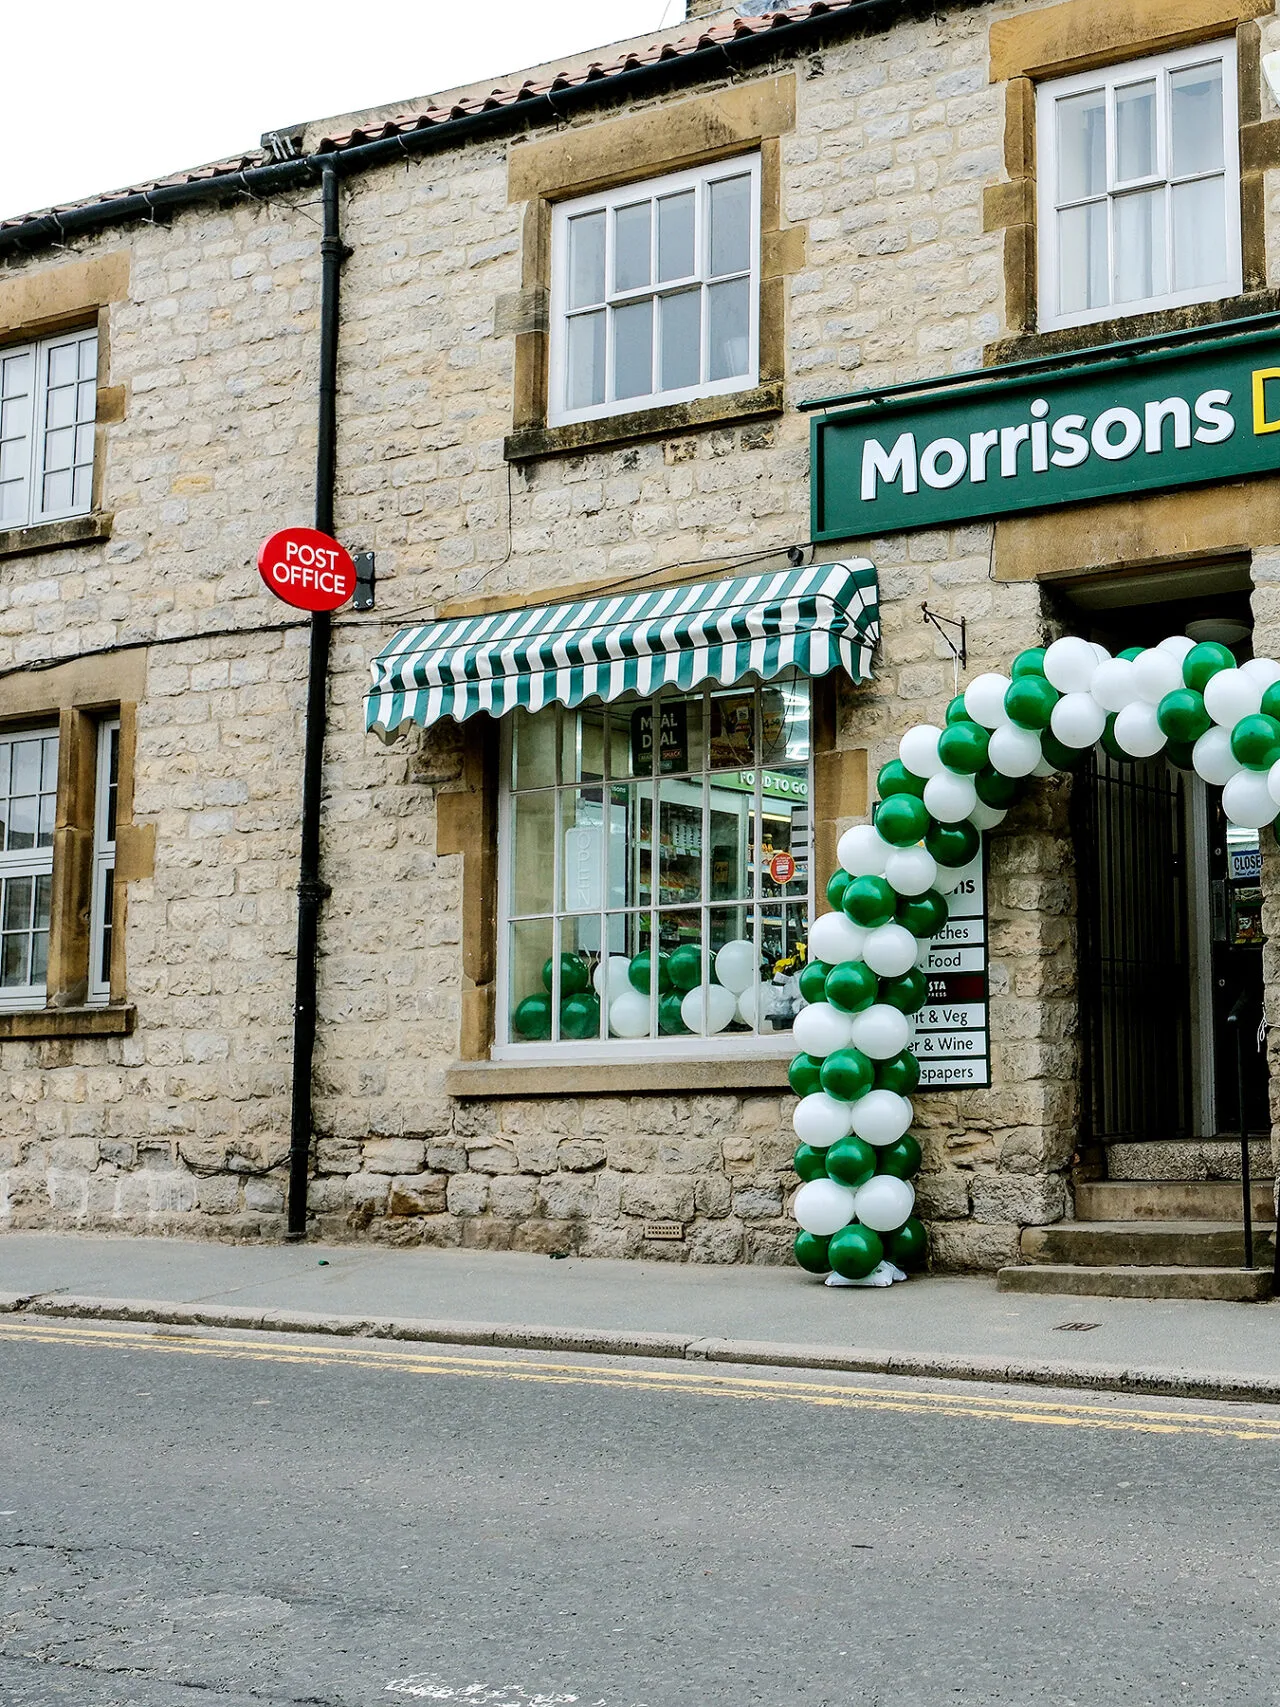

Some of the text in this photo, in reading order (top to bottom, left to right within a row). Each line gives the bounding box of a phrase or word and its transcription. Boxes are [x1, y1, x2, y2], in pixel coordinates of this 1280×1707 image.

[860, 389, 1236, 501] Morrisons
[286, 541, 339, 570] POST
[272, 562, 346, 595] OFFICE
[641, 713, 678, 731] MAL
[642, 731, 678, 748] DAL
[740, 771, 808, 795] FOD TO GO
[577, 832, 591, 906] OPEN
[928, 951, 961, 968] Food
[928, 980, 947, 992] STA
[928, 1009, 938, 1024] &
[942, 1009, 968, 1027] Veg
[907, 1036, 974, 1052] er & Wine
[921, 1067, 974, 1083] spapers
